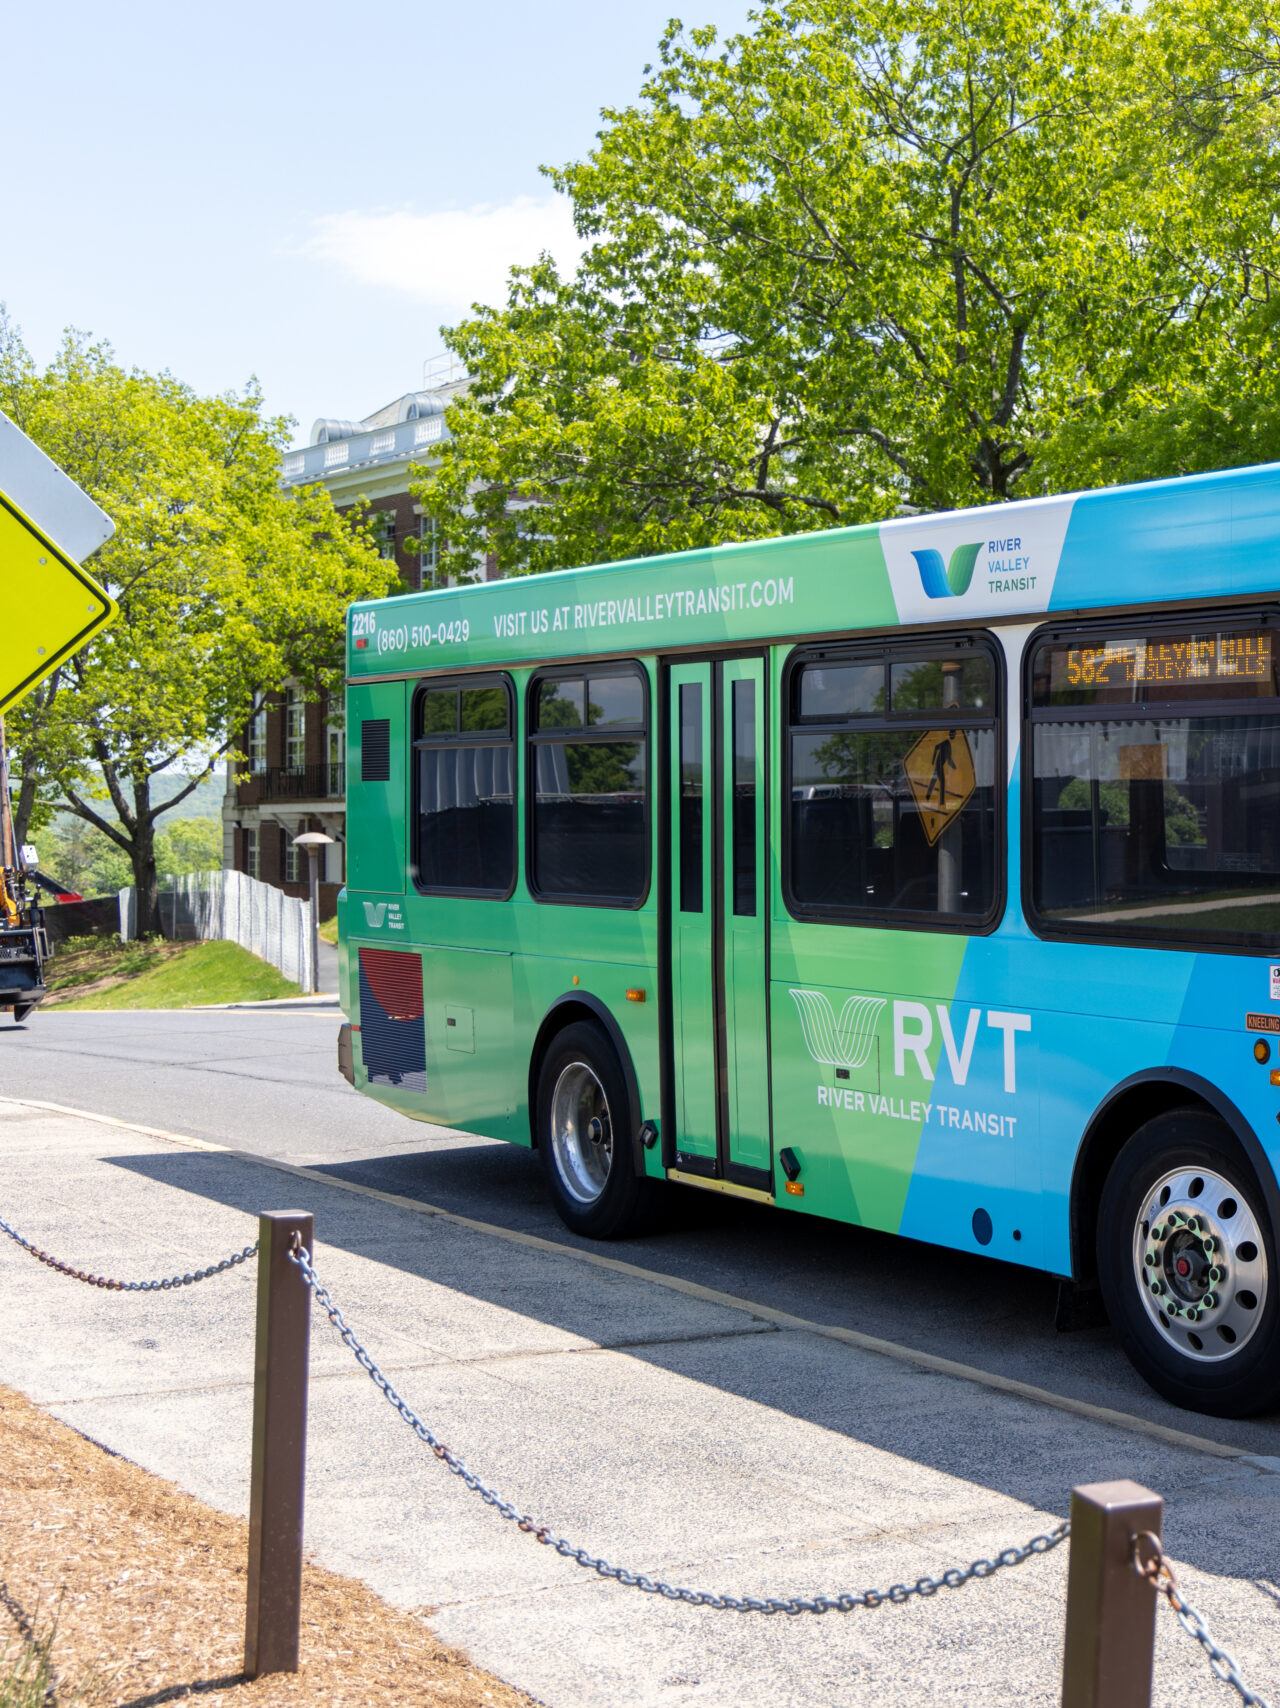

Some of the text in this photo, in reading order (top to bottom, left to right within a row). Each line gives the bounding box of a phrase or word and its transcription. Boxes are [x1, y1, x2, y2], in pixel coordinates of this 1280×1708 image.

[988, 537, 1022, 553] RIVER
[988, 557, 1030, 573] VALLEY
[988, 576, 1037, 593] TRANSIT
[494, 576, 794, 638] VISIT US AT RIVERVALLEYTRANSIT.COM
[352, 611, 376, 636] 2216
[377, 619, 470, 656] (860) 510-0429
[1067, 648, 1112, 684] 582
[1222, 637, 1269, 657] HILL
[1126, 656, 1265, 681] WESLEYAN HILLS
[1248, 1015, 1280, 1031] KNEELING
[893, 999, 1032, 1094] RVT
[817, 1085, 1017, 1139] RIVER VALLEY TRANSIT
